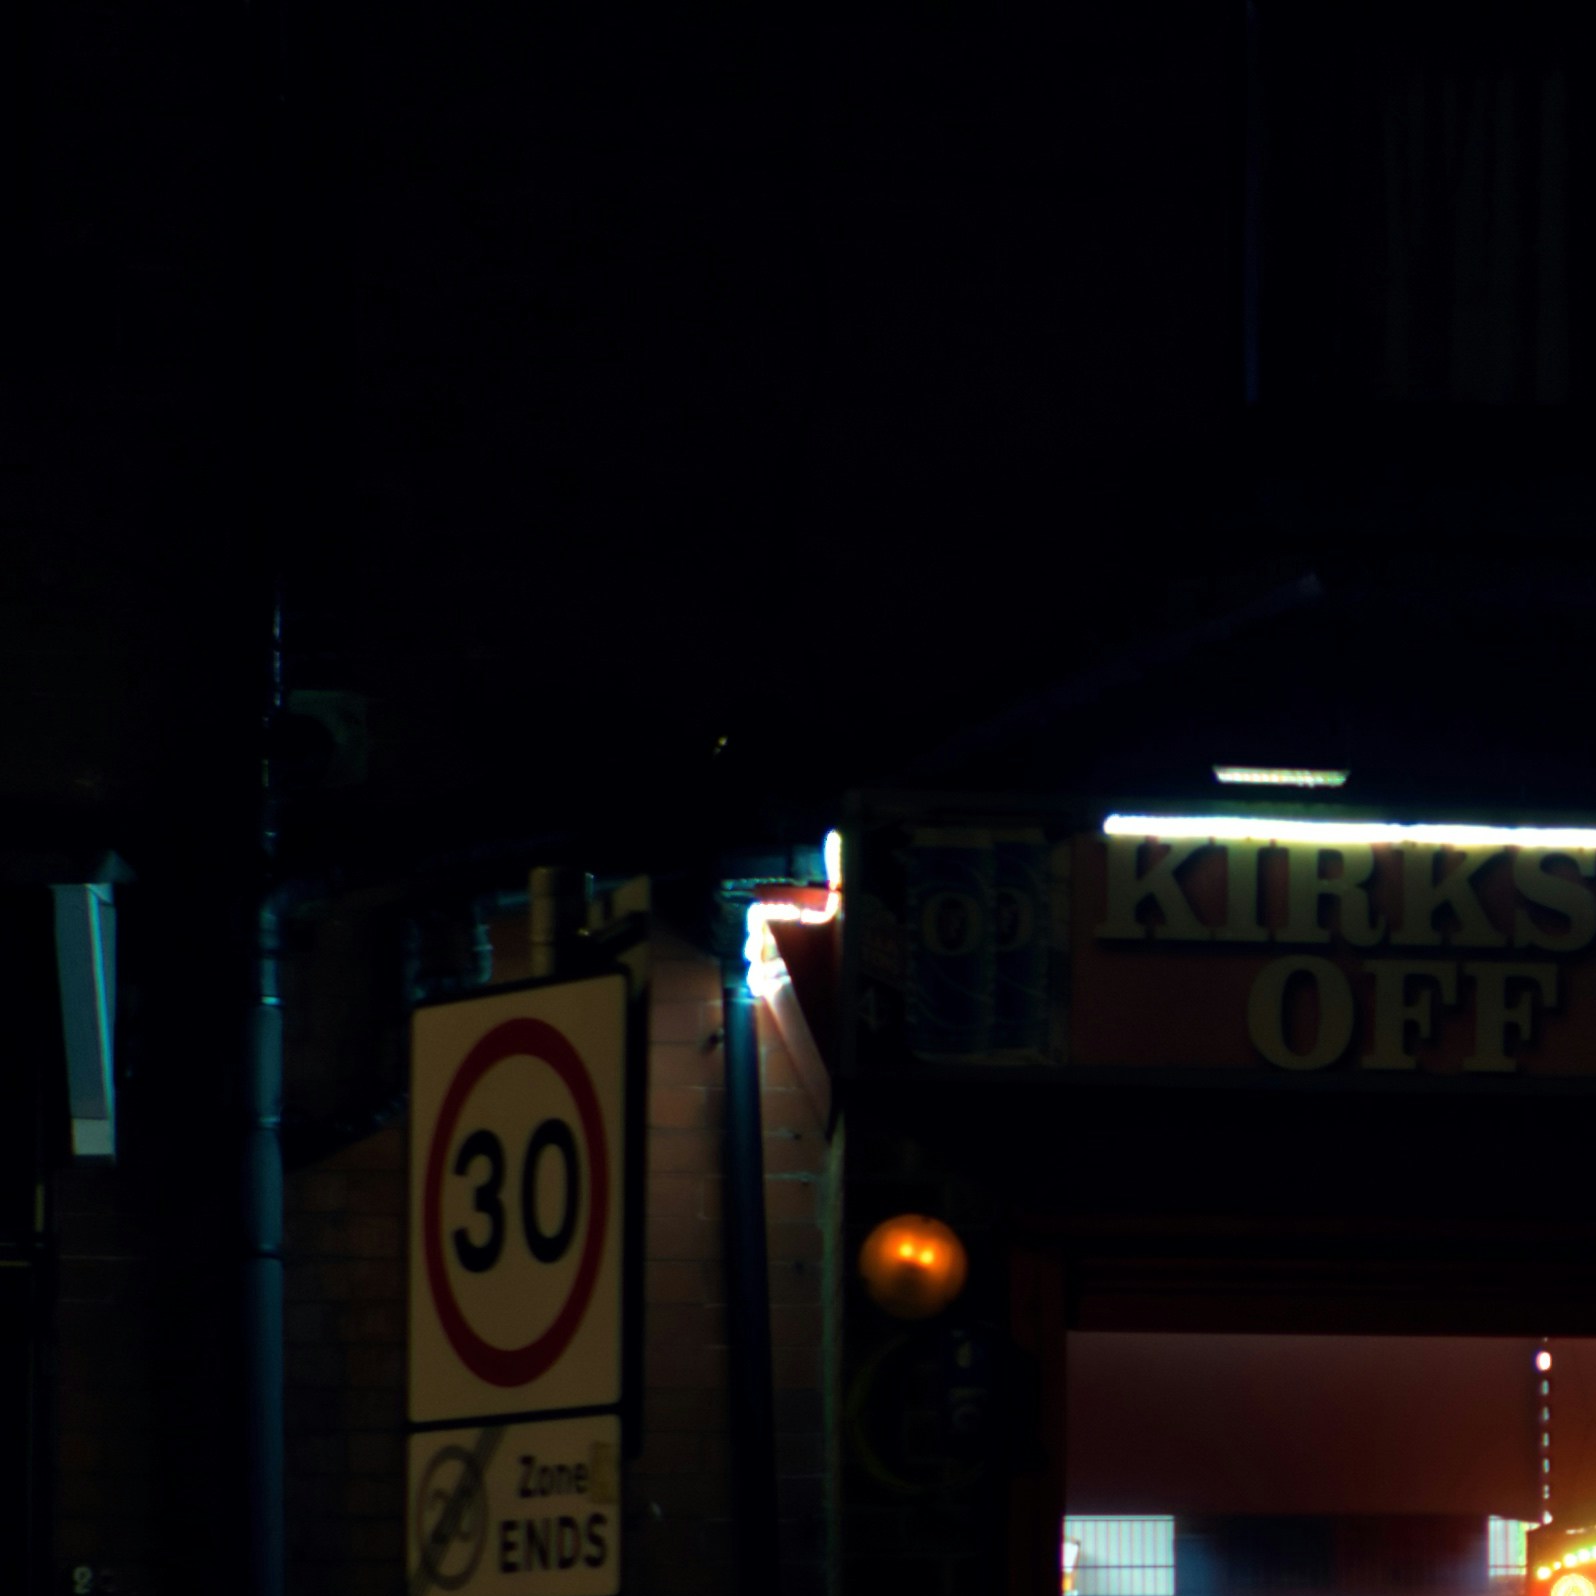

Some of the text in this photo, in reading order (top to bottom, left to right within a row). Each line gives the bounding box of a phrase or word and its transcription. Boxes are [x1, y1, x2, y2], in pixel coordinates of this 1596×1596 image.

[1246, 953, 1562, 1073] OFF
[454, 1118, 579, 1273] 30
[518, 1456, 588, 1498] Zone
[500, 1513, 607, 1573] ENDS
